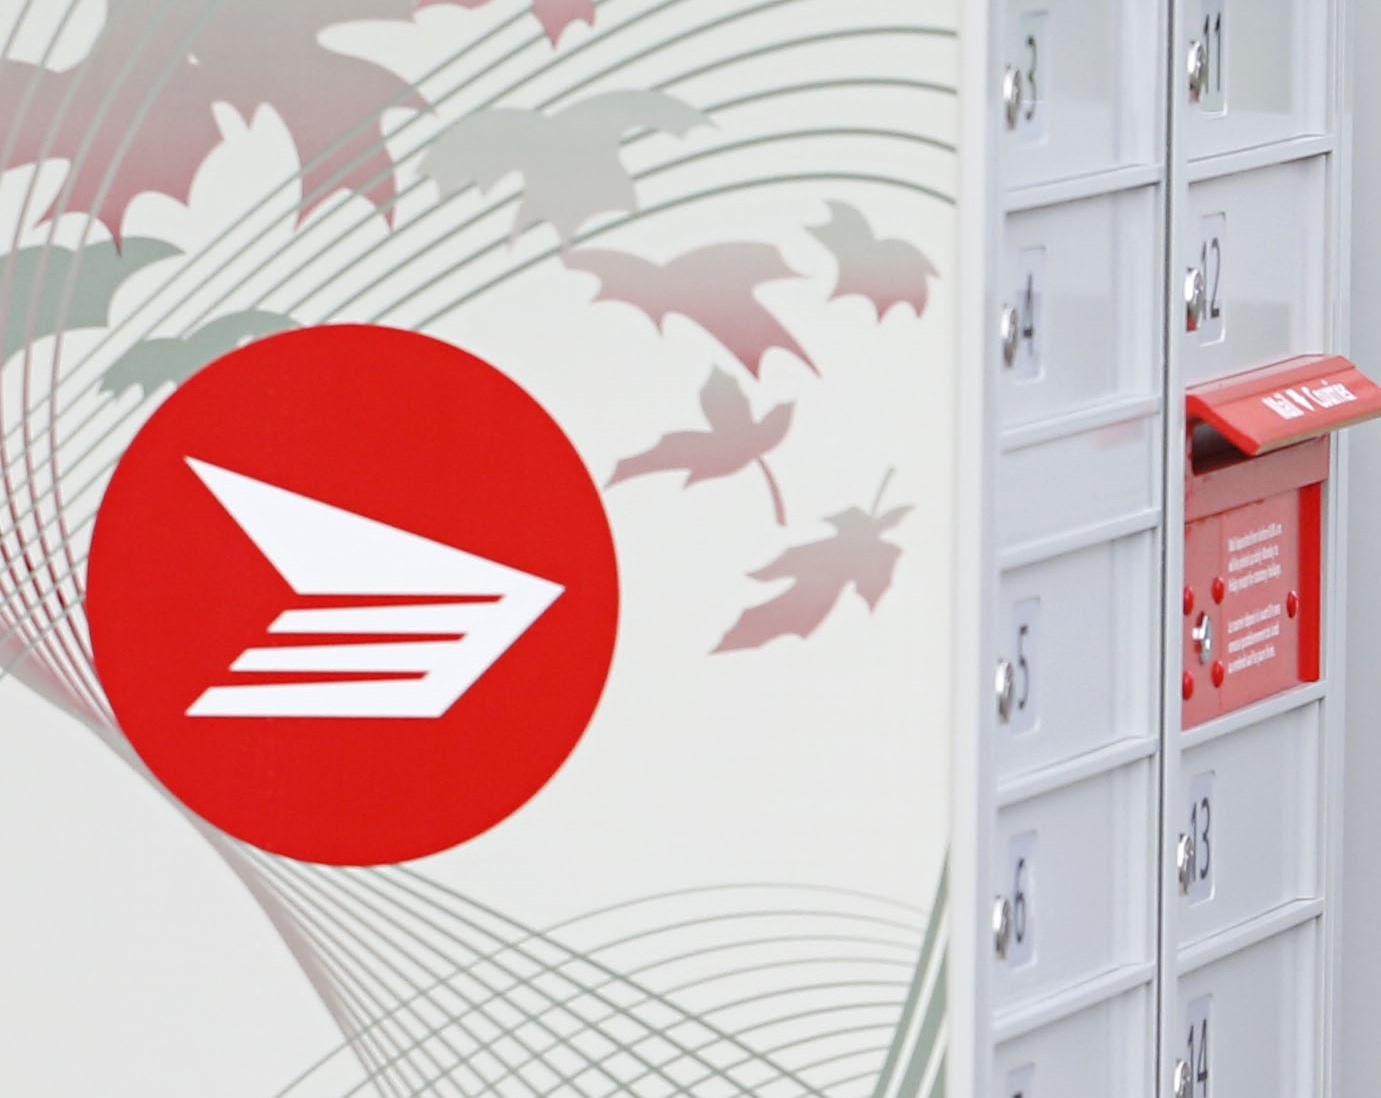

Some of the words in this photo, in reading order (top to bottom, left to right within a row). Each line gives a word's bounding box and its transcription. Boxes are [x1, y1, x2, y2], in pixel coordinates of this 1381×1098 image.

[1027, 36, 1037, 120] 3
[1204, 12, 1220, 93] 11
[1023, 272, 1034, 357] 4
[1202, 237, 1220, 320] 12
[1019, 624, 1029, 710] 5
[1191, 797, 1210, 883] 13
[1015, 857, 1026, 943] 6
